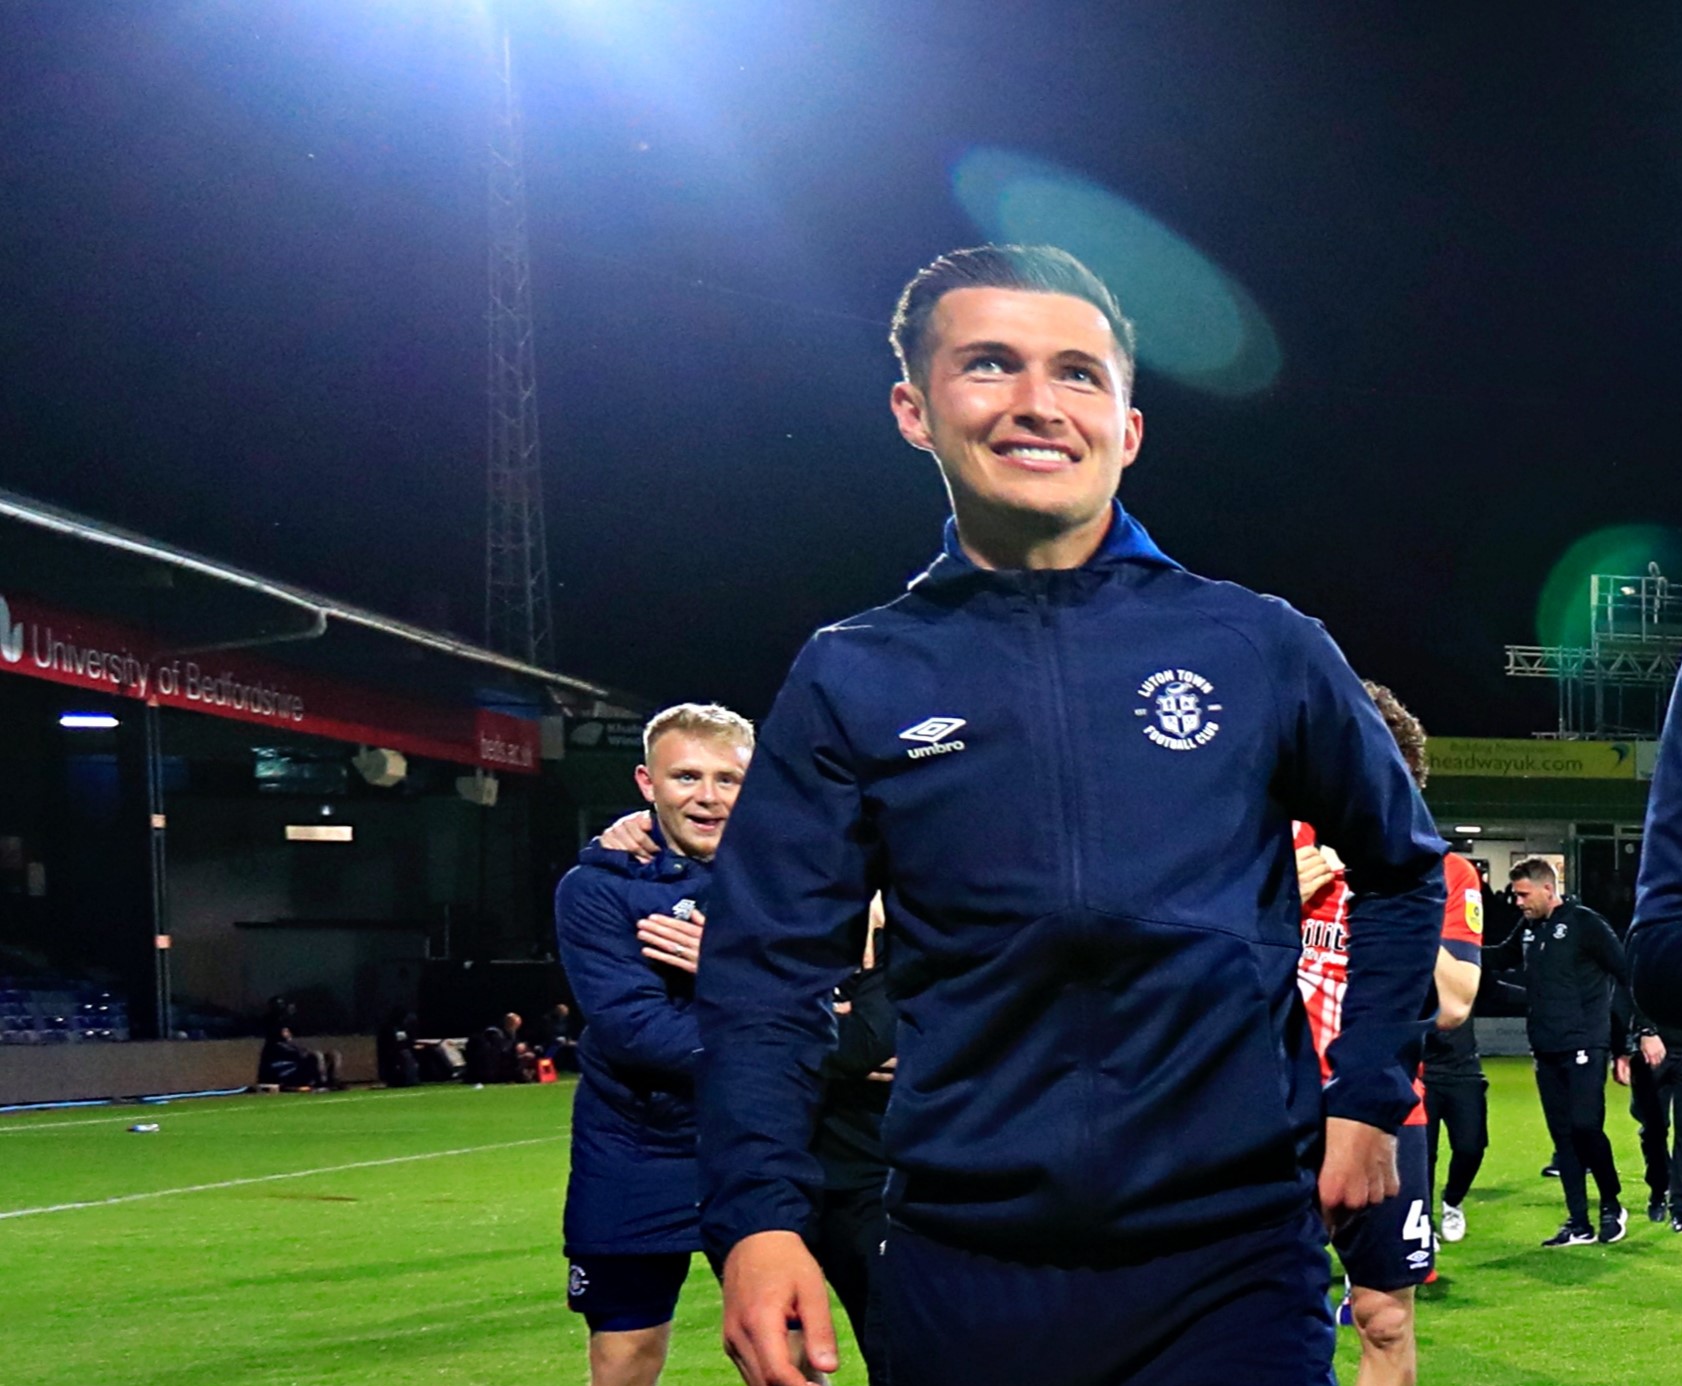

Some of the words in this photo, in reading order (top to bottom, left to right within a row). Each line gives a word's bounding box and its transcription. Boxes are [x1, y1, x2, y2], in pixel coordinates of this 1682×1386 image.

[32, 624, 148, 697] University
[159, 660, 180, 695] of
[186, 662, 304, 722] Bedfordshire
[1137, 669, 1175, 697] LUTON
[1176, 669, 1214, 694] TOWN
[907, 741, 965, 759] umbro
[1143, 725, 1197, 750] FOOTBALL
[1195, 721, 1219, 745] CLUB
[1431, 753, 1583, 774] headwayuk.com
[1302, 918, 1347, 951] ilit
[1402, 1199, 1431, 1249] 4
